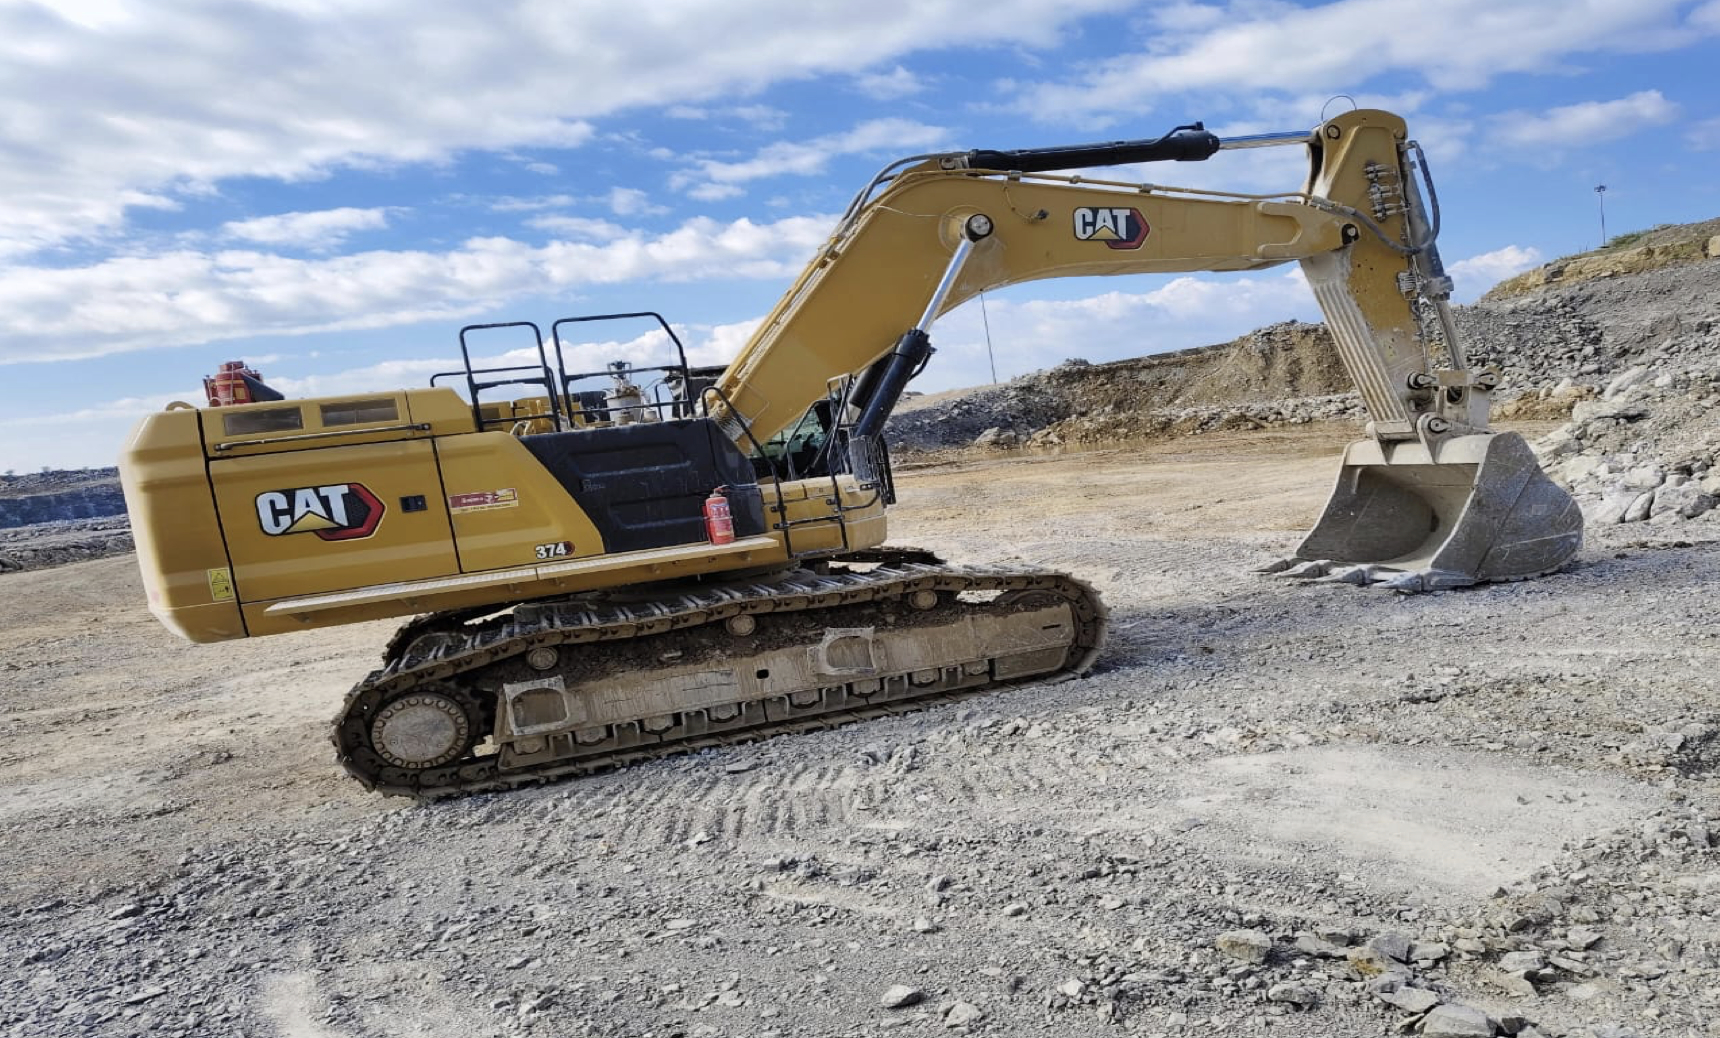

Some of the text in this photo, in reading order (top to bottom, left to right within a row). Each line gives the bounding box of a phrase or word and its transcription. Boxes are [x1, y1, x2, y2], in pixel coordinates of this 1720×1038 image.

[1074, 207, 1131, 240] CAT
[255, 484, 349, 535] CAT
[535, 542, 567, 559] 374
